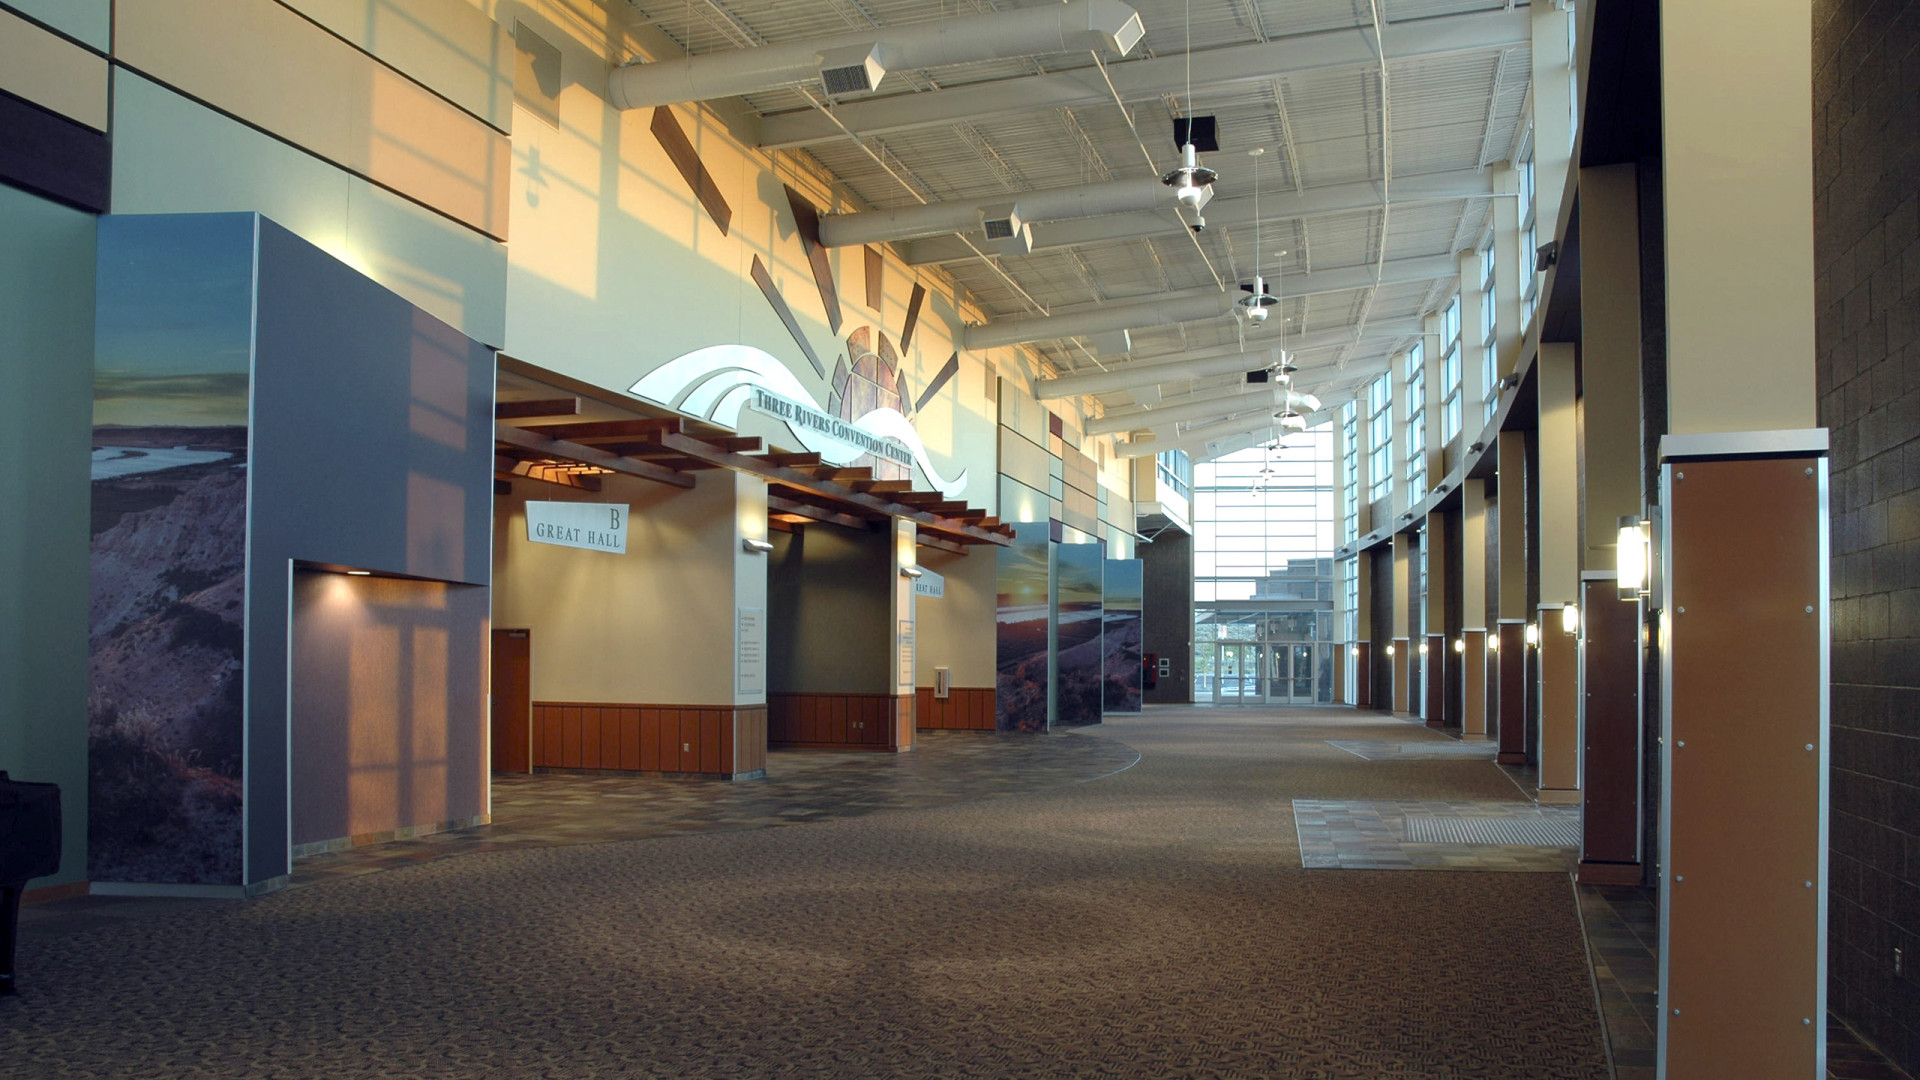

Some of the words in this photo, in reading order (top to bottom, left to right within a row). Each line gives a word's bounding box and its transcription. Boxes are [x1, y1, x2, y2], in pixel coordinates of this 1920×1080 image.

[756, 389, 793, 422] THREE
[794, 403, 831, 434] RIVERS
[832, 418, 884, 456] CONVENTION
[885, 443, 912, 467] CENTER
[609, 508, 620, 530] B
[536, 522, 581, 542] GREAT
[588, 530, 620, 548] HALL
[915, 583, 928, 592] REAT
